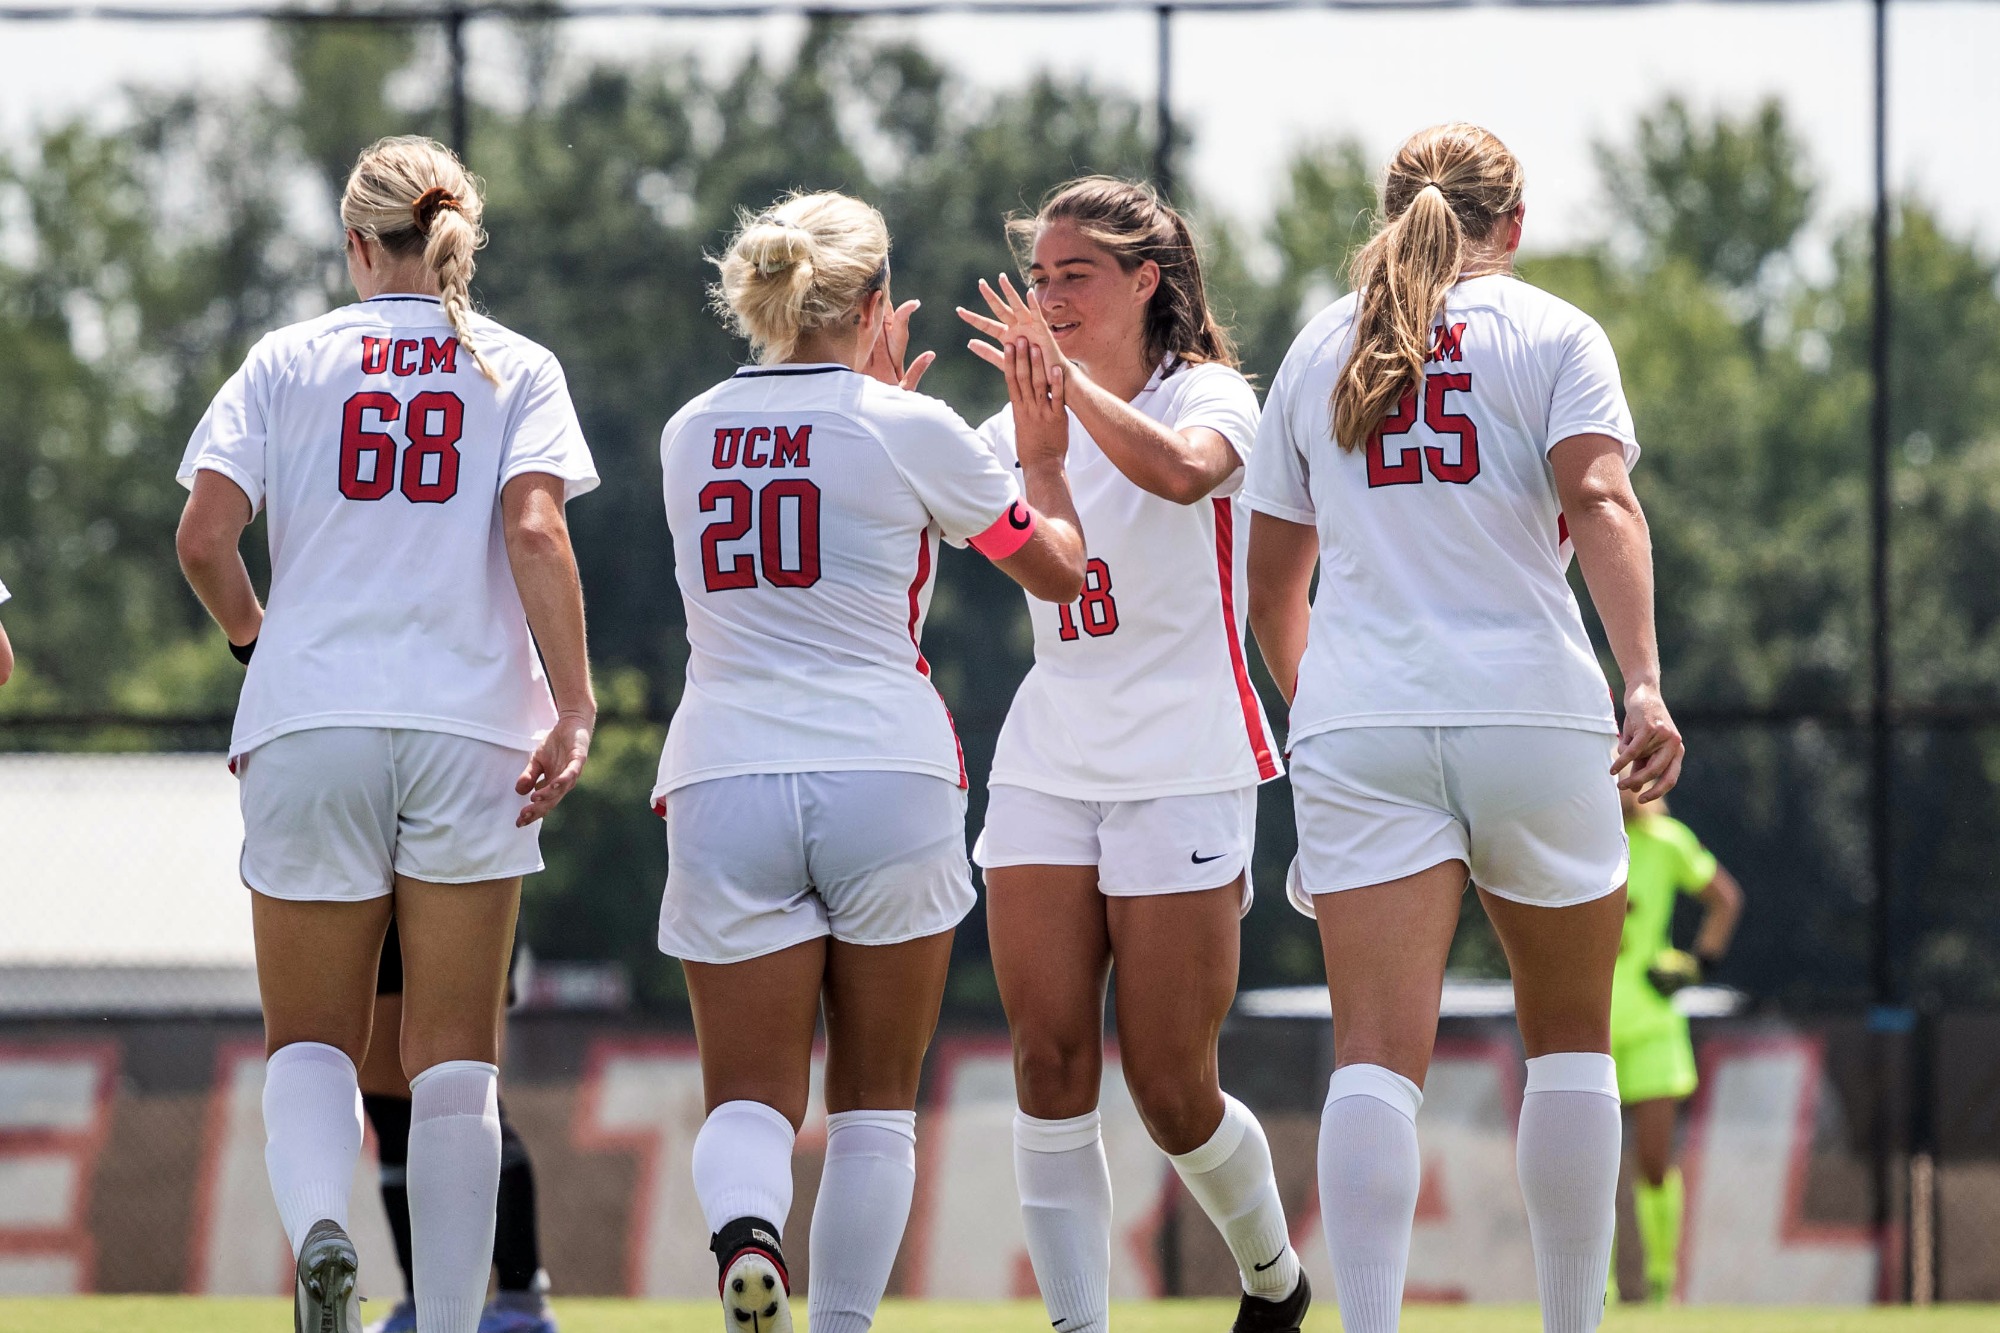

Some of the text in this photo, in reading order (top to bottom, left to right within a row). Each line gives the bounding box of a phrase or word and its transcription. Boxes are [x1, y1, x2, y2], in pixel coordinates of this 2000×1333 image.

[361, 335, 460, 376] UCM
[338, 391, 464, 504] 68
[712, 425, 812, 469] UCM
[1366, 372, 1480, 488] 25
[699, 479, 821, 593] 20
[1009, 501, 1031, 530] C
